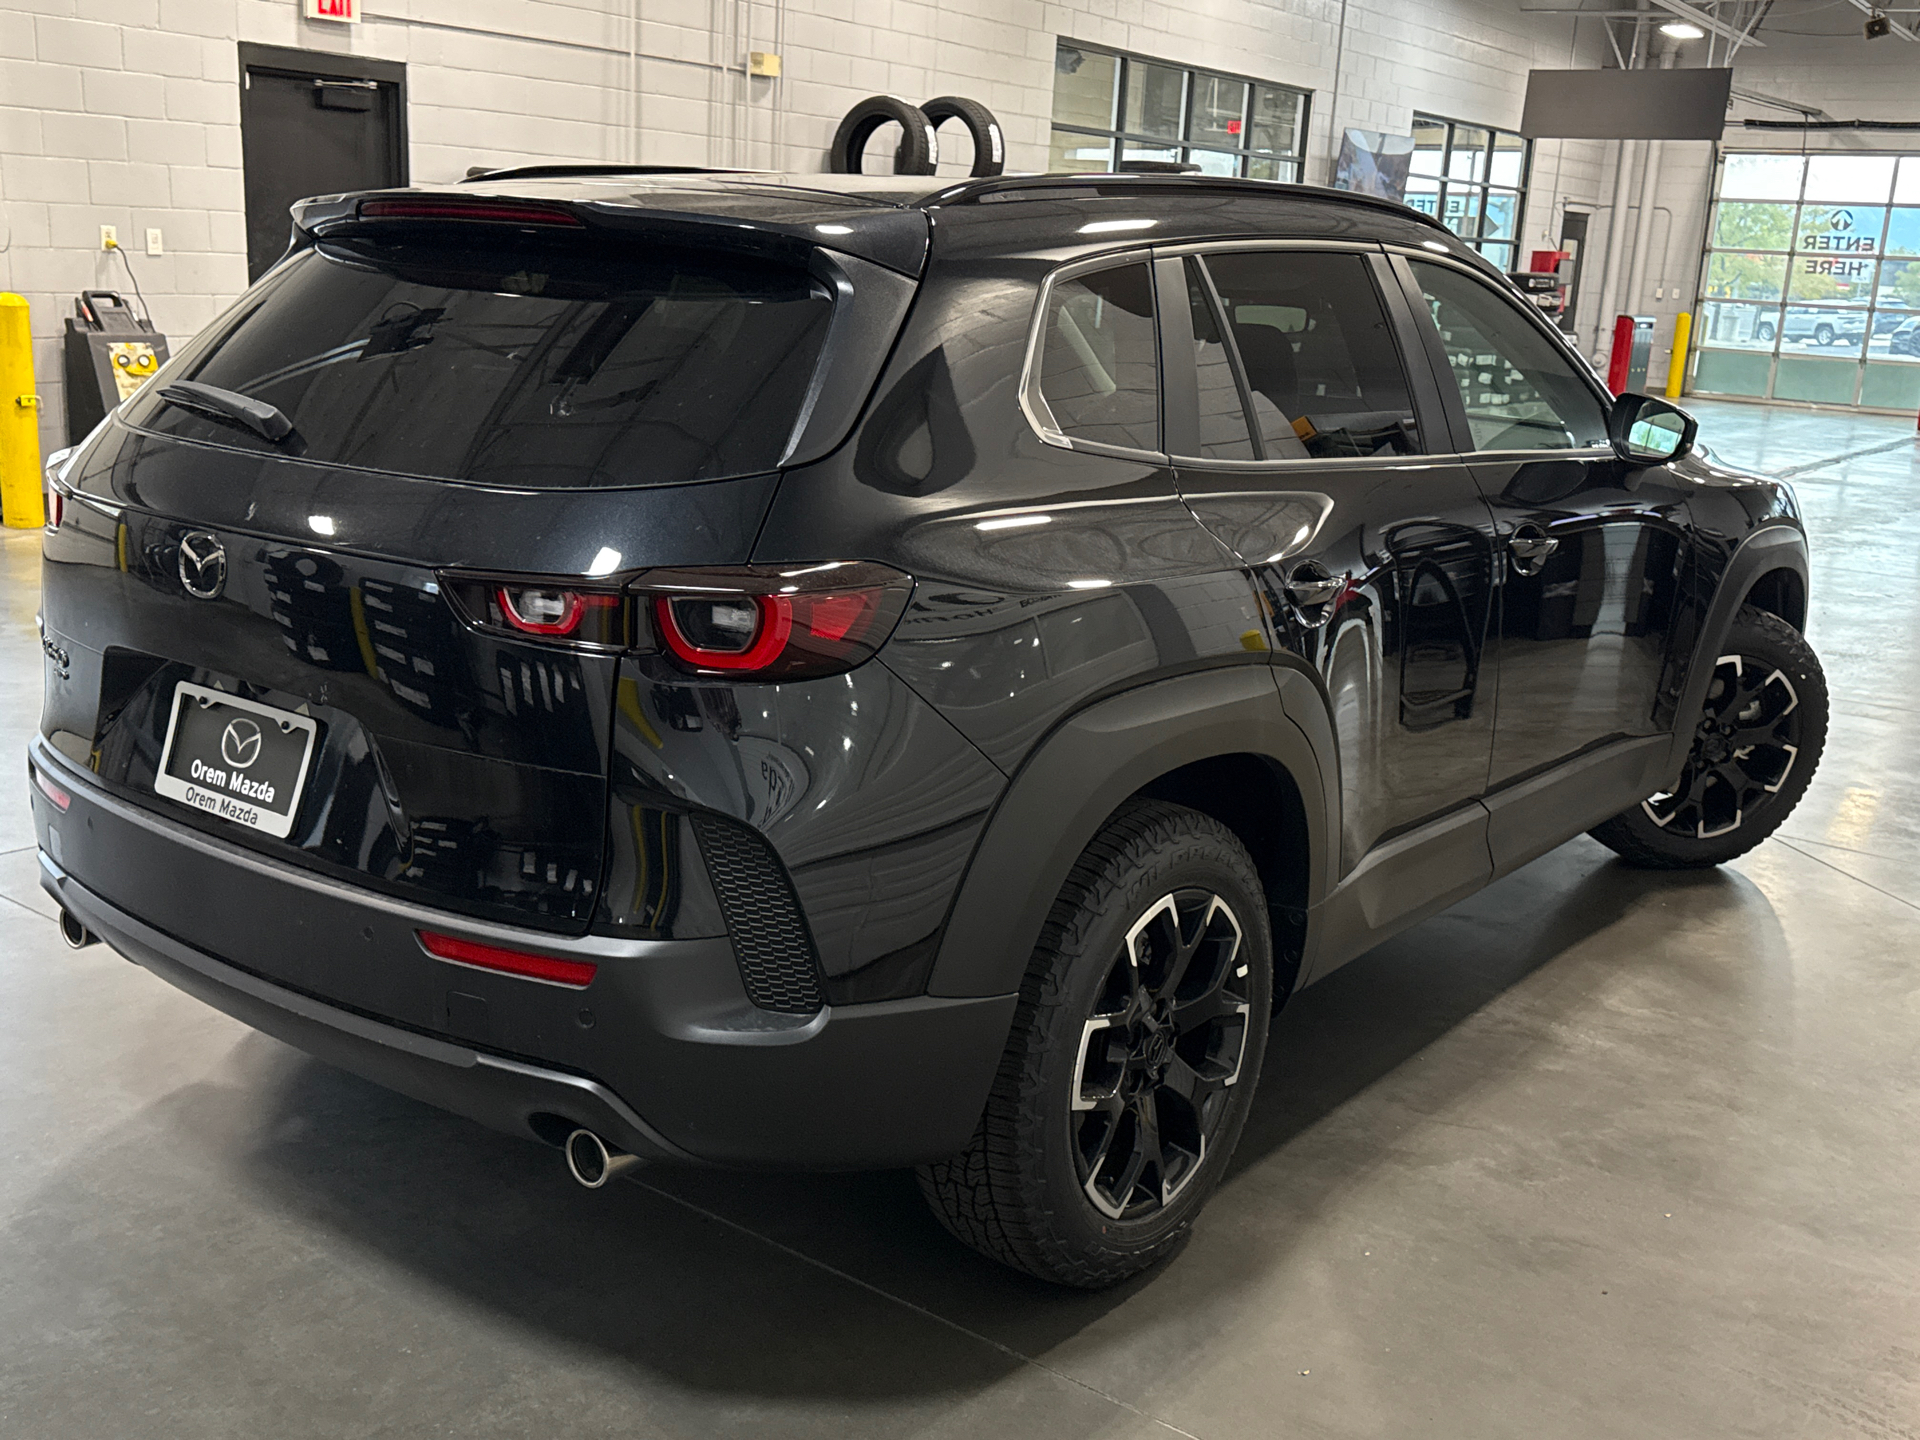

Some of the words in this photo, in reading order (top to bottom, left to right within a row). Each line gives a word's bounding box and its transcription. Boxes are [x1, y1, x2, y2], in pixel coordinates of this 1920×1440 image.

[191, 758, 226, 788] Orem
[229, 771, 275, 803] Mazda
[185, 786, 216, 810] Orem
[218, 798, 258, 825] Mazda
